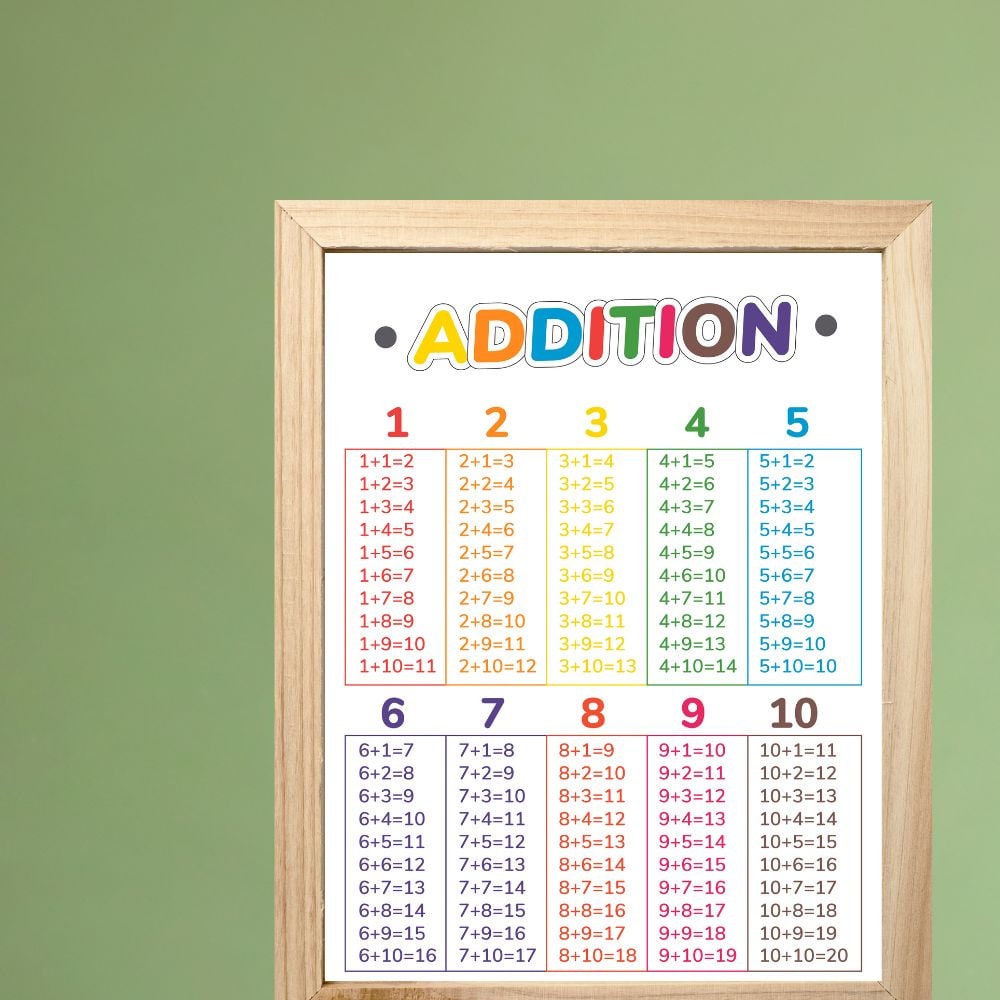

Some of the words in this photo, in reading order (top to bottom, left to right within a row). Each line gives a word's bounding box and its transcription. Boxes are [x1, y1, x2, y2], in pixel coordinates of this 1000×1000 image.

[410, 298, 795, 368] ADDITION
[386, 406, 409, 438] 1
[484, 405, 509, 438] 2
[584, 405, 609, 439] 3
[684, 406, 710, 438] 4
[785, 406, 810, 439] 5
[359, 453, 415, 469] 1+1=2
[459, 453, 514, 469] 2+1=3
[559, 453, 615, 469] 3+1=4
[658, 453, 715, 469] 4+1=5
[759, 453, 815, 469] 5+1=2
[359, 476, 414, 492] 1+2=3
[459, 476, 515, 492] 2+2=4
[658, 476, 715, 492] 4+2=6
[759, 476, 815, 492] 5+2=3
[360, 522, 415, 537] 1+4=5
[459, 521, 515, 537] 2+4=6
[658, 522, 715, 537] 4+4=8
[759, 522, 815, 537] 5+4=5
[360, 544, 415, 560] 1+5=6
[459, 544, 514, 560] 2+5=7
[658, 544, 715, 560] 4+5=9
[759, 544, 815, 560] 5+5=6
[360, 590, 415, 606] 1+7=8
[459, 590, 515, 606] 2+7=9
[659, 590, 726, 606] 4+7=11
[759, 590, 815, 606] 5+7=8
[360, 613, 415, 629] 1+8=9
[459, 613, 526, 629] 2+8=10
[658, 613, 726, 629] 4+8=12
[759, 613, 815, 629] 5+8=9
[360, 658, 437, 674] 1+10=11
[459, 658, 537, 674] 2+10=12
[658, 658, 738, 674] 4+10=14
[759, 658, 837, 674] 5+10=10
[381, 696, 405, 729] 6
[481, 697, 505, 729] 7
[581, 696, 606, 729] 8
[681, 696, 706, 729] 9
[770, 696, 818, 729] 10
[358, 742, 414, 758] 6+1=7
[459, 742, 515, 758] 7+1=8
[558, 742, 615, 758] 8+1=9
[658, 742, 726, 758] 9+1=10
[760, 742, 837, 758] 10+1=11
[358, 765, 415, 781] 6+2=8
[459, 765, 515, 781] 7+2=9
[558, 765, 626, 781] 8+2=10
[658, 765, 726, 781] 9+2=11
[760, 765, 837, 781] 10+2=12
[358, 811, 426, 826] 6+4=10
[458, 811, 526, 826] 7+4=11
[558, 811, 626, 827] 8+4=12
[658, 811, 726, 827] 9+4=13
[760, 811, 838, 826] 10+4=14
[358, 834, 425, 849] 6+5=11
[458, 834, 526, 849] 7+5=12
[558, 834, 626, 849] 8+5=13
[658, 834, 727, 849] 9+5=14
[760, 834, 837, 849] 10+5=15
[358, 879, 425, 895] 6+7=13
[458, 879, 527, 895] 7+7=14
[558, 879, 626, 895] 8+7=15
[658, 879, 726, 895] 9+7=16
[760, 879, 837, 895] 10+7=17
[358, 902, 426, 918] 6+8=14
[458, 902, 526, 918] 7+8=15
[558, 902, 626, 918] 8+8=16
[658, 902, 726, 918] 9+8=17
[760, 902, 837, 918] 10+8=18
[358, 947, 437, 963] 6+10=16
[458, 947, 537, 963] 7+10=17
[558, 947, 637, 963] 8+10=18
[658, 947, 737, 963] 9+10=19
[760, 947, 849, 963] 10+10=20
